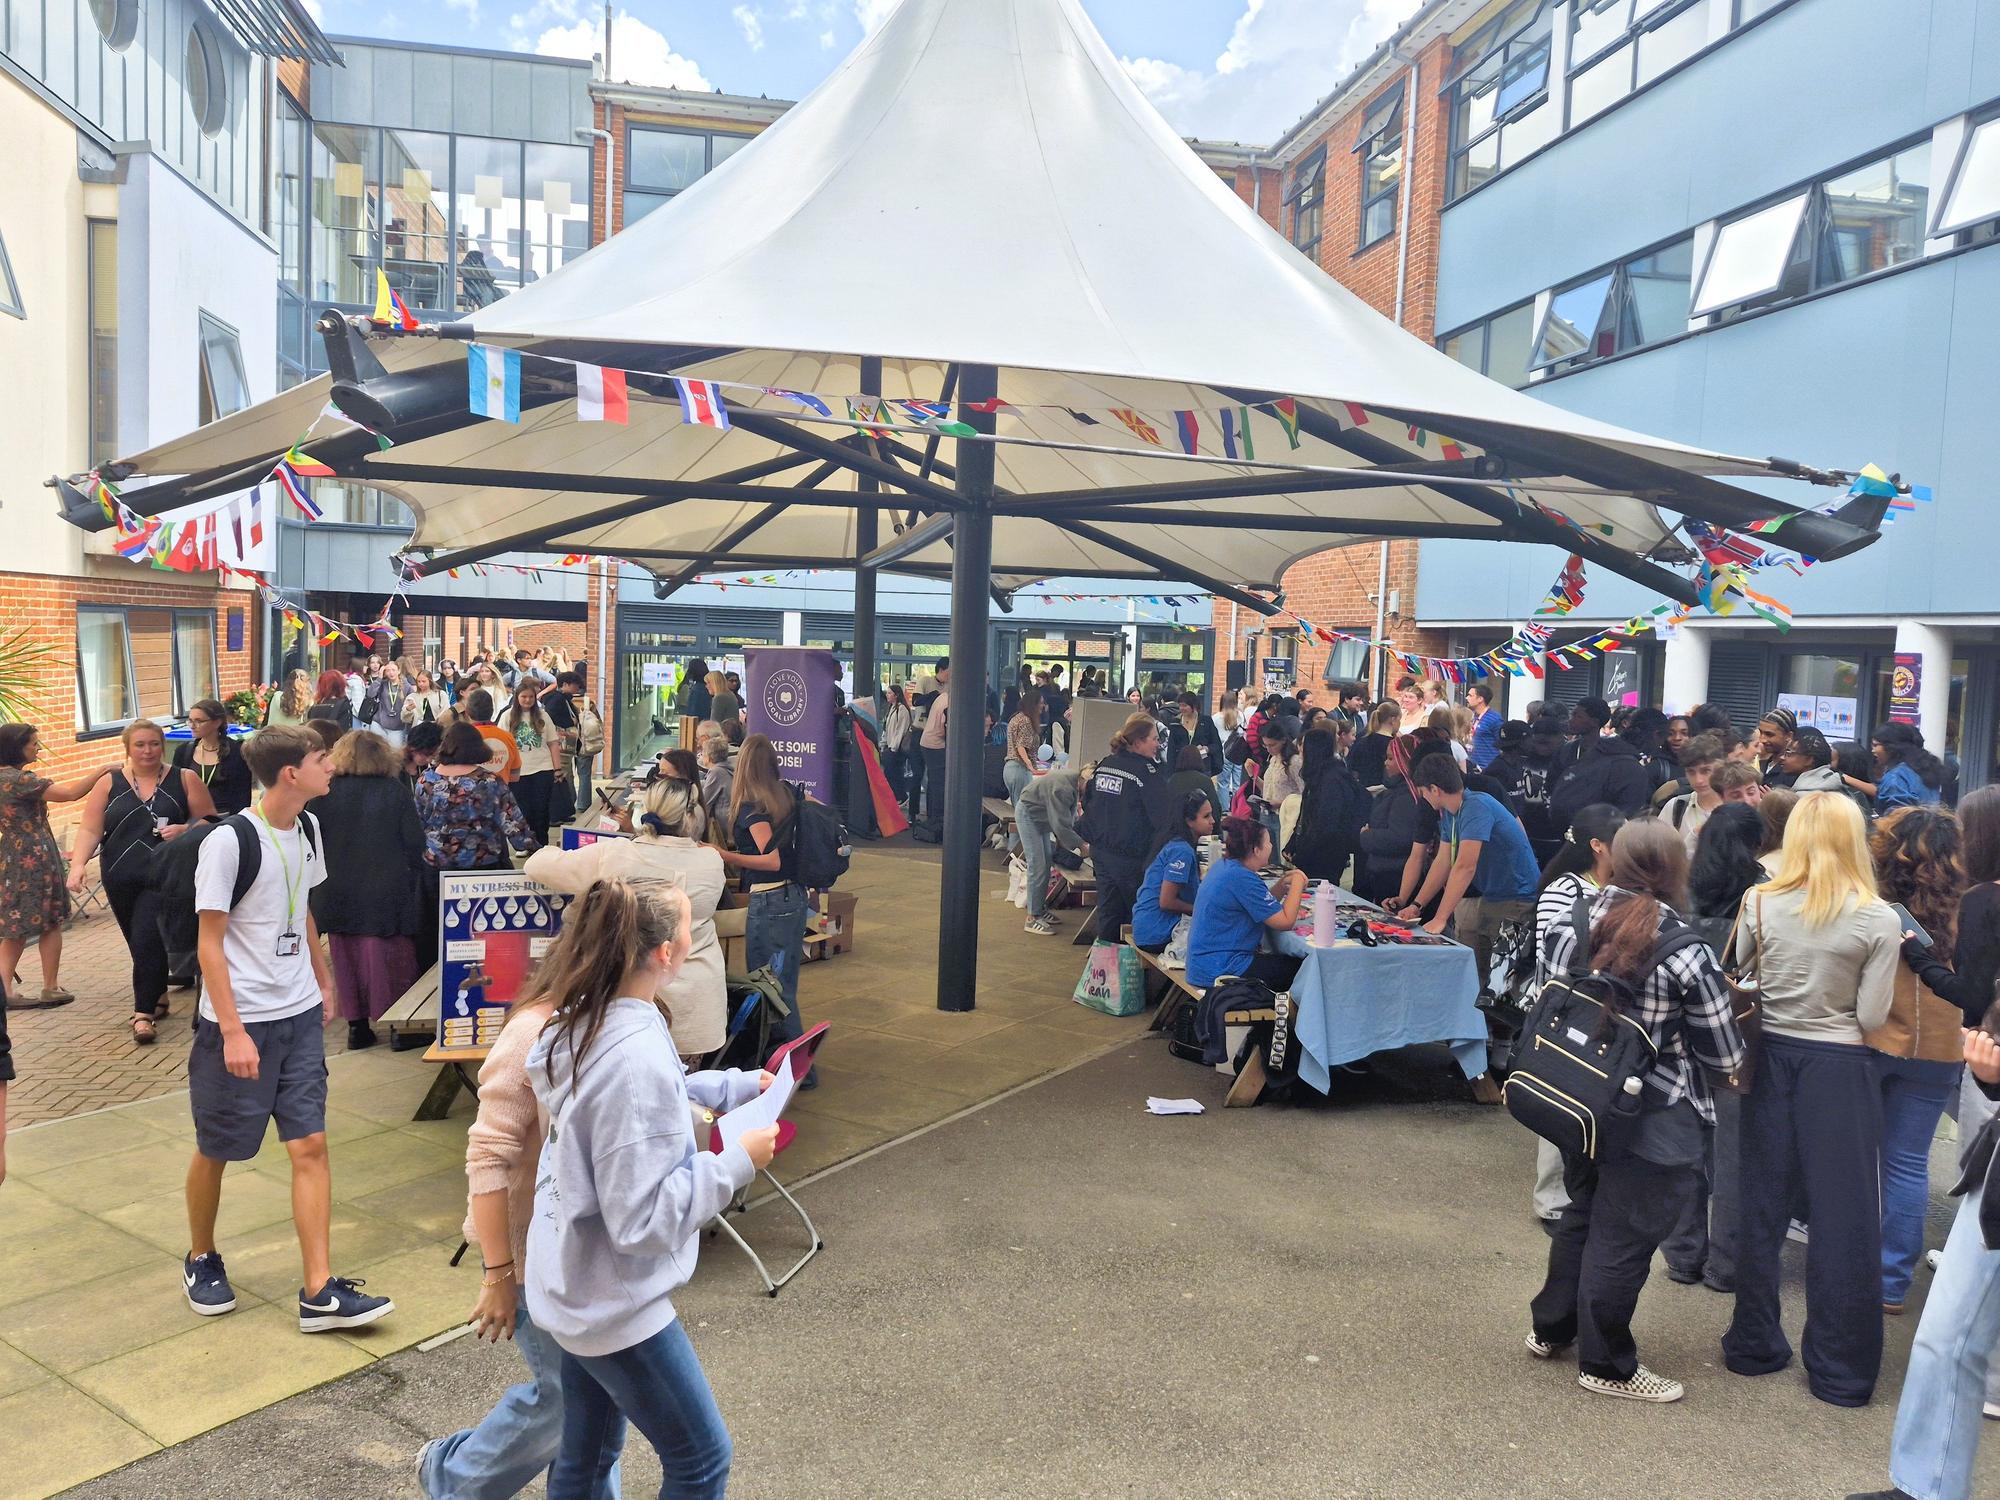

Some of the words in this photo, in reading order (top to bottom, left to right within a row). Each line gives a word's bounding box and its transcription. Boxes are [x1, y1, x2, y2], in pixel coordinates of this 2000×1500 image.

[770, 673, 785, 689] LOVE
[787, 673, 803, 690] YOUR
[767, 697, 782, 720] LOCAL
[783, 697, 804, 721] LIBRARY
[770, 740, 785, 752] KE
[786, 741, 817, 754] SOME
[776, 755, 803, 768] OISE!
[450, 884, 468, 894] MY
[471, 881, 520, 894] STRESS
[523, 881, 551, 891] BUC
